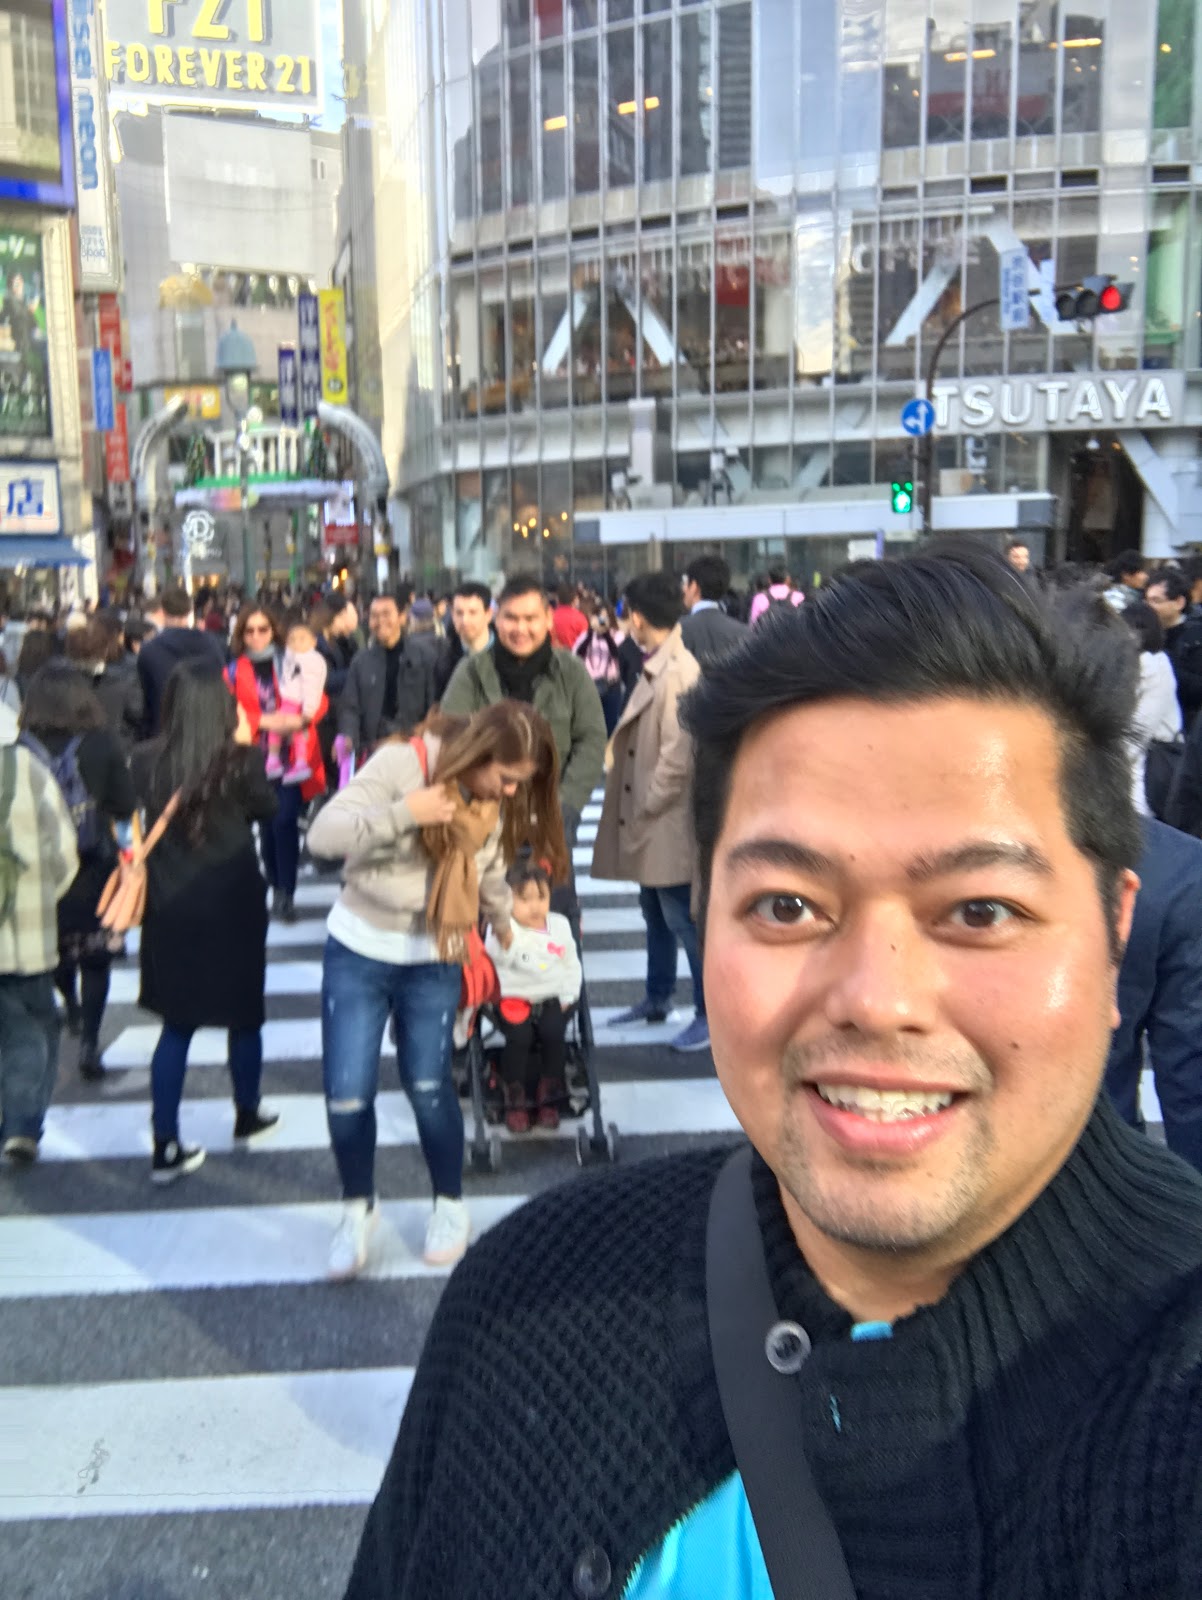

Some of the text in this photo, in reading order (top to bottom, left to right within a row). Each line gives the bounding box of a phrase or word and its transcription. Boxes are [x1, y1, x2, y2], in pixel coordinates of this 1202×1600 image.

[104, 40, 311, 94] FOREVER 21
[931, 377, 1171, 428] TSUTAYA
